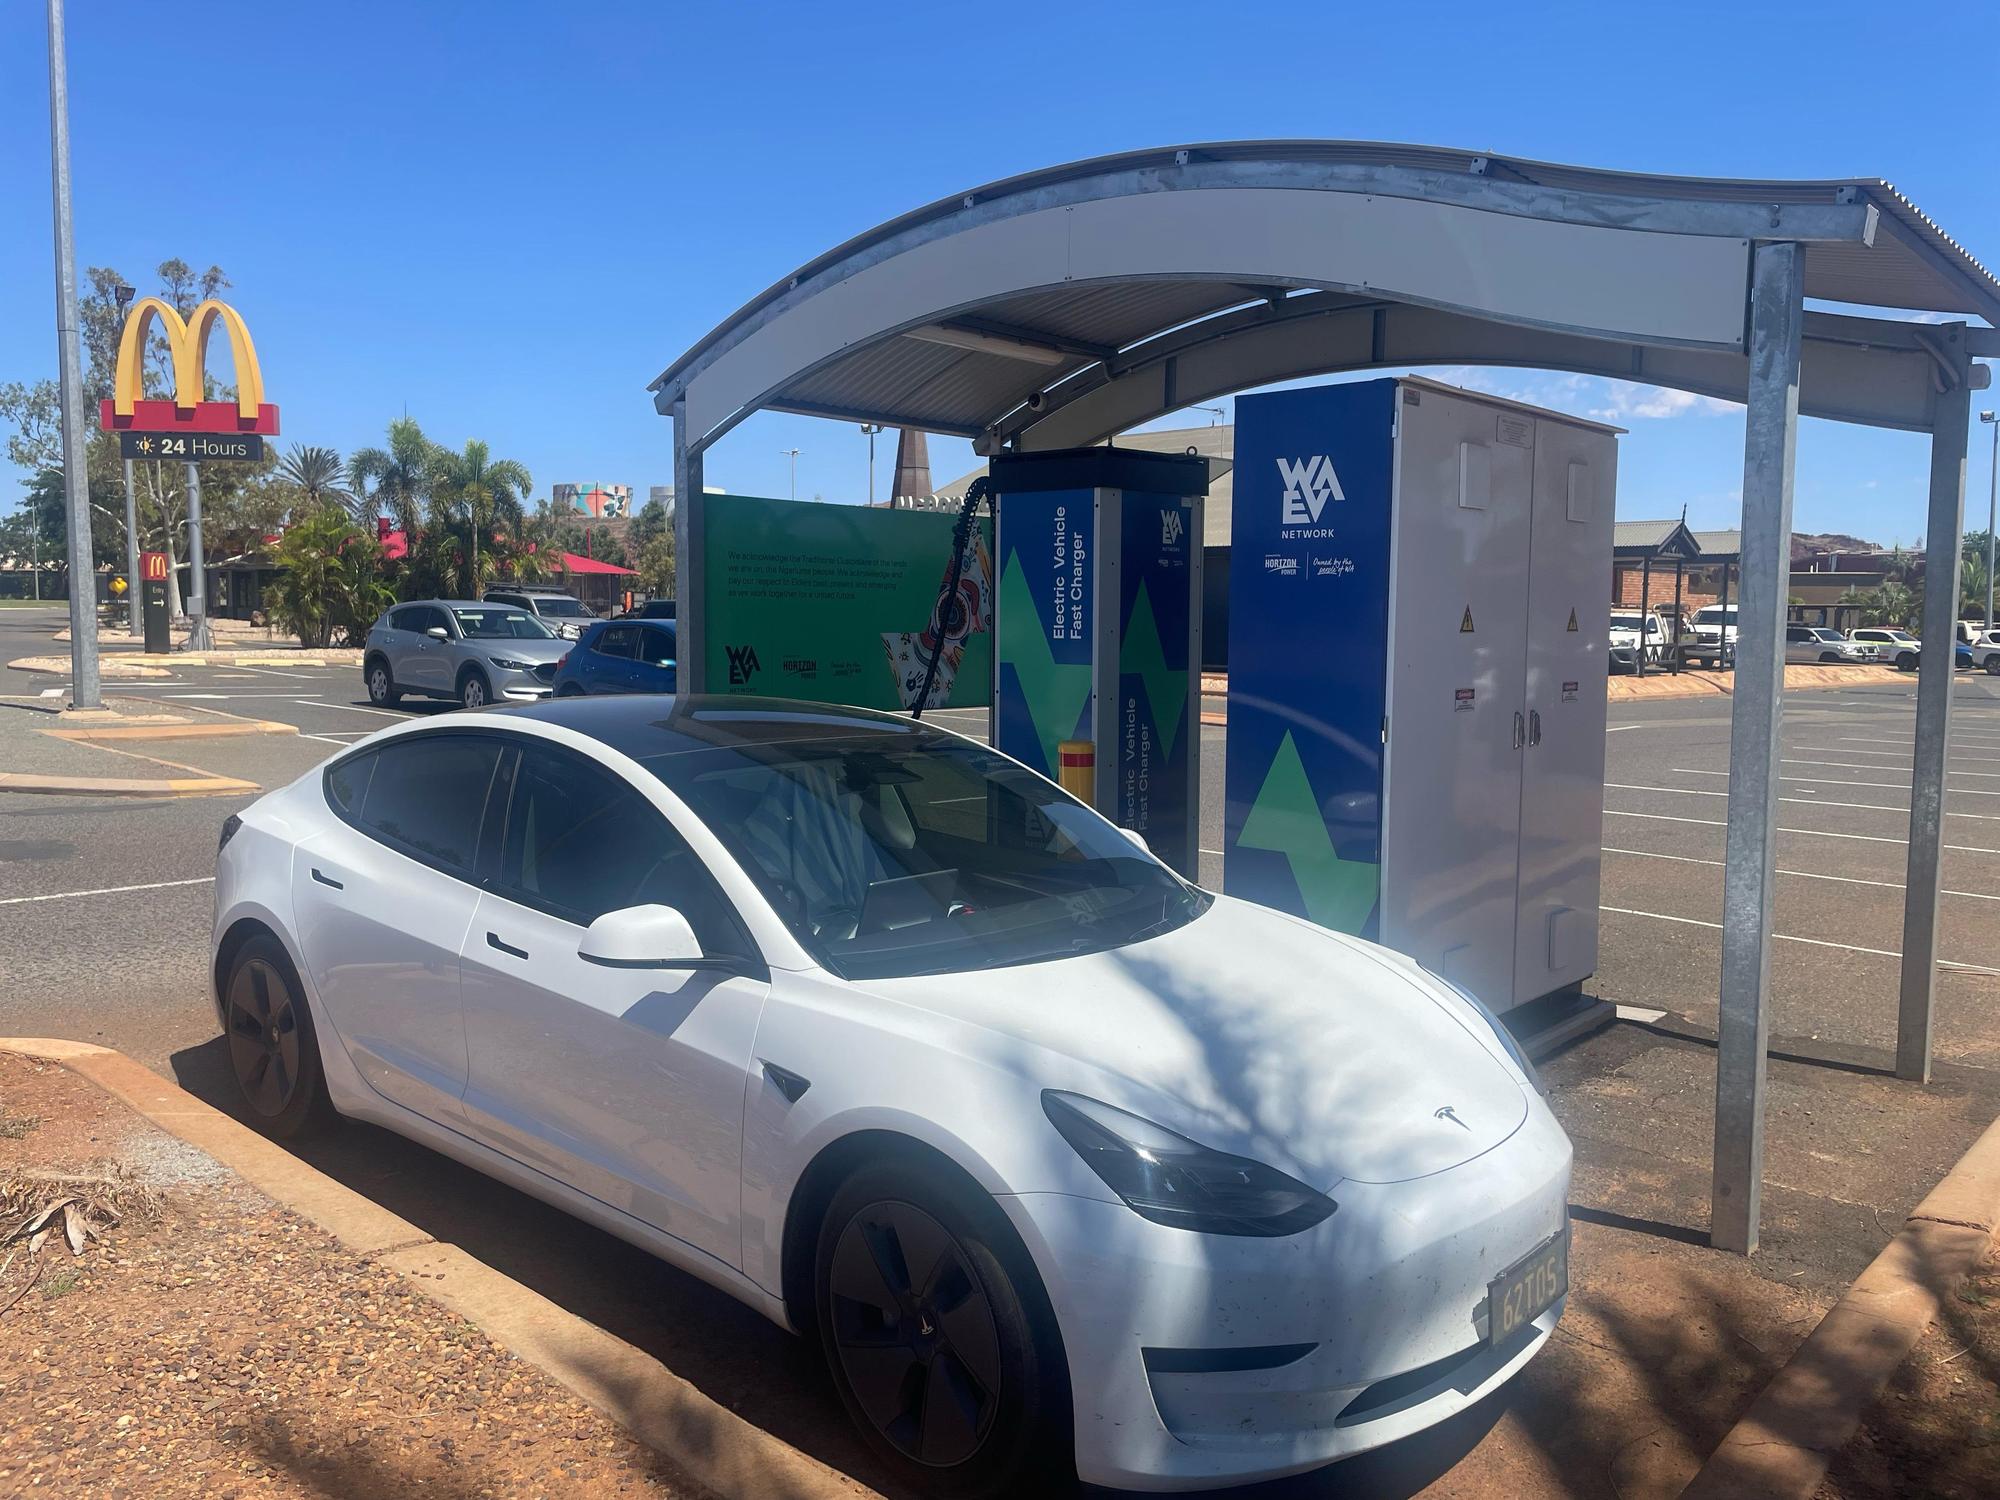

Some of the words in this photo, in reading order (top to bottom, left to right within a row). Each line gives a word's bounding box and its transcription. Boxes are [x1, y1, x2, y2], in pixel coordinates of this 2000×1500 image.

[161, 438, 186, 454] 24
[192, 439, 247, 456] Hours
[1054, 506, 1066, 569] Vehicle
[1281, 529, 1335, 540] NETWORK
[1070, 532, 1086, 601] Charger
[1264, 558, 1297, 569] HORIZON
[152, 586, 164, 595] Entry
[1053, 576, 1065, 639] Electric
[1070, 605, 1083, 639] Fast
[1126, 698, 1136, 762] Vehicle
[1139, 723, 1151, 792] Charger
[1138, 796, 1149, 831] Fast
